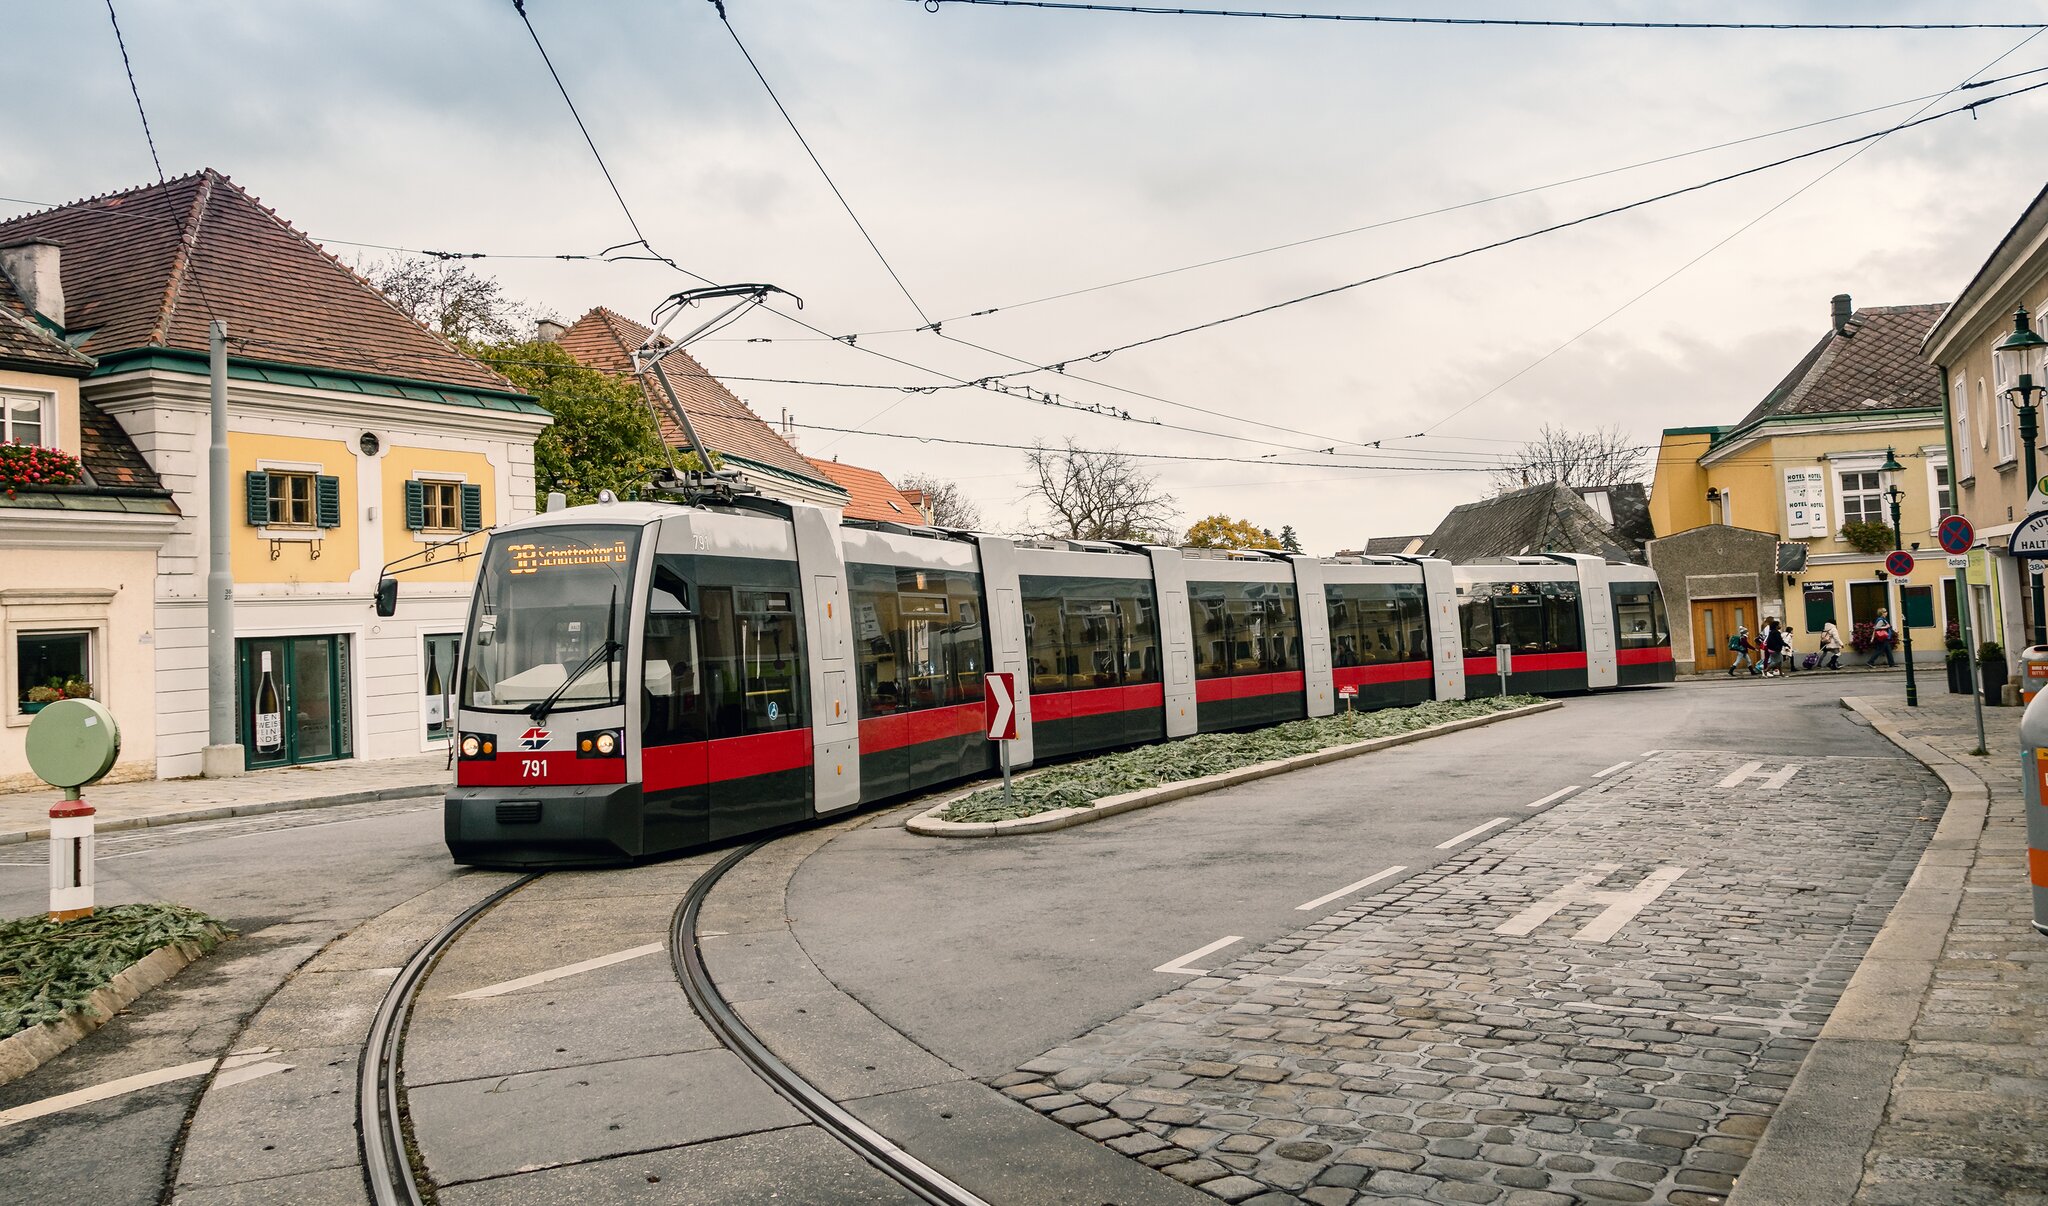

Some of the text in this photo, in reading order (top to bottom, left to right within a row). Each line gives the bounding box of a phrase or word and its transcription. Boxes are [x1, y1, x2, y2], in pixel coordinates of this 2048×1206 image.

[692, 534, 709, 550] 791
[2021, 540, 2048, 550] HALT
[507, 544, 538, 574] 38
[539, 543, 614, 567] Schottentor
[1949, 558, 1967, 567] Anfang
[522, 760, 547, 777] 791
